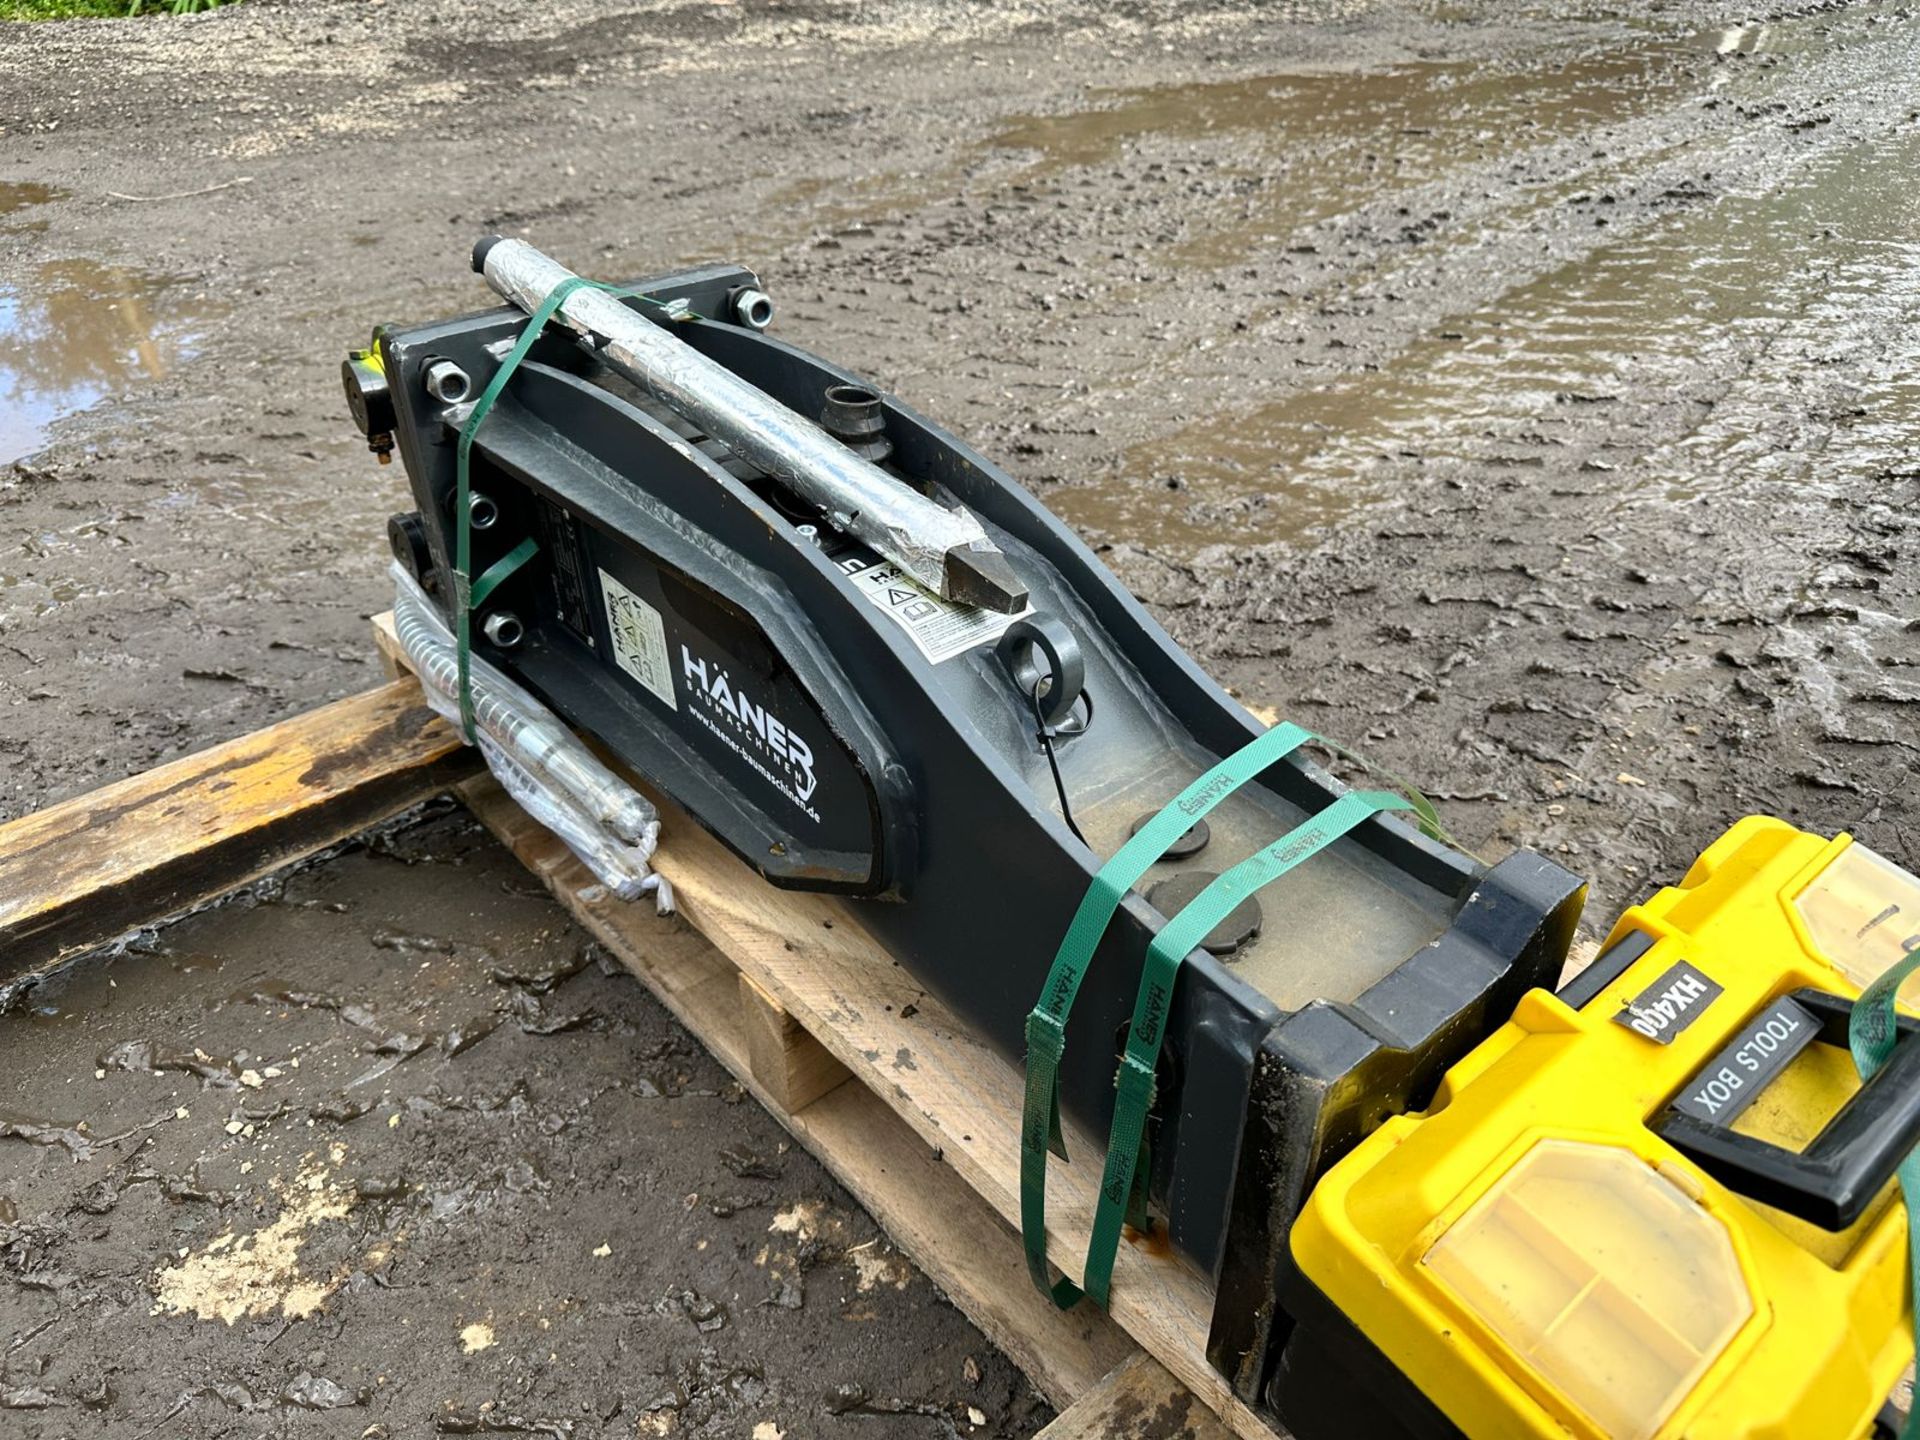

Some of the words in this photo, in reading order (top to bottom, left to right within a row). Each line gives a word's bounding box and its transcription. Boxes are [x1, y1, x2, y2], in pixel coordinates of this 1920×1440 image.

[681, 643, 817, 801] HÄNER
[686, 679, 803, 783] BAUMASCHINEN
[688, 704, 821, 824] www.haener-baumaschinen.de
[1694, 1067, 1744, 1115] BOX
[1735, 1012, 1801, 1071] TOOLS
